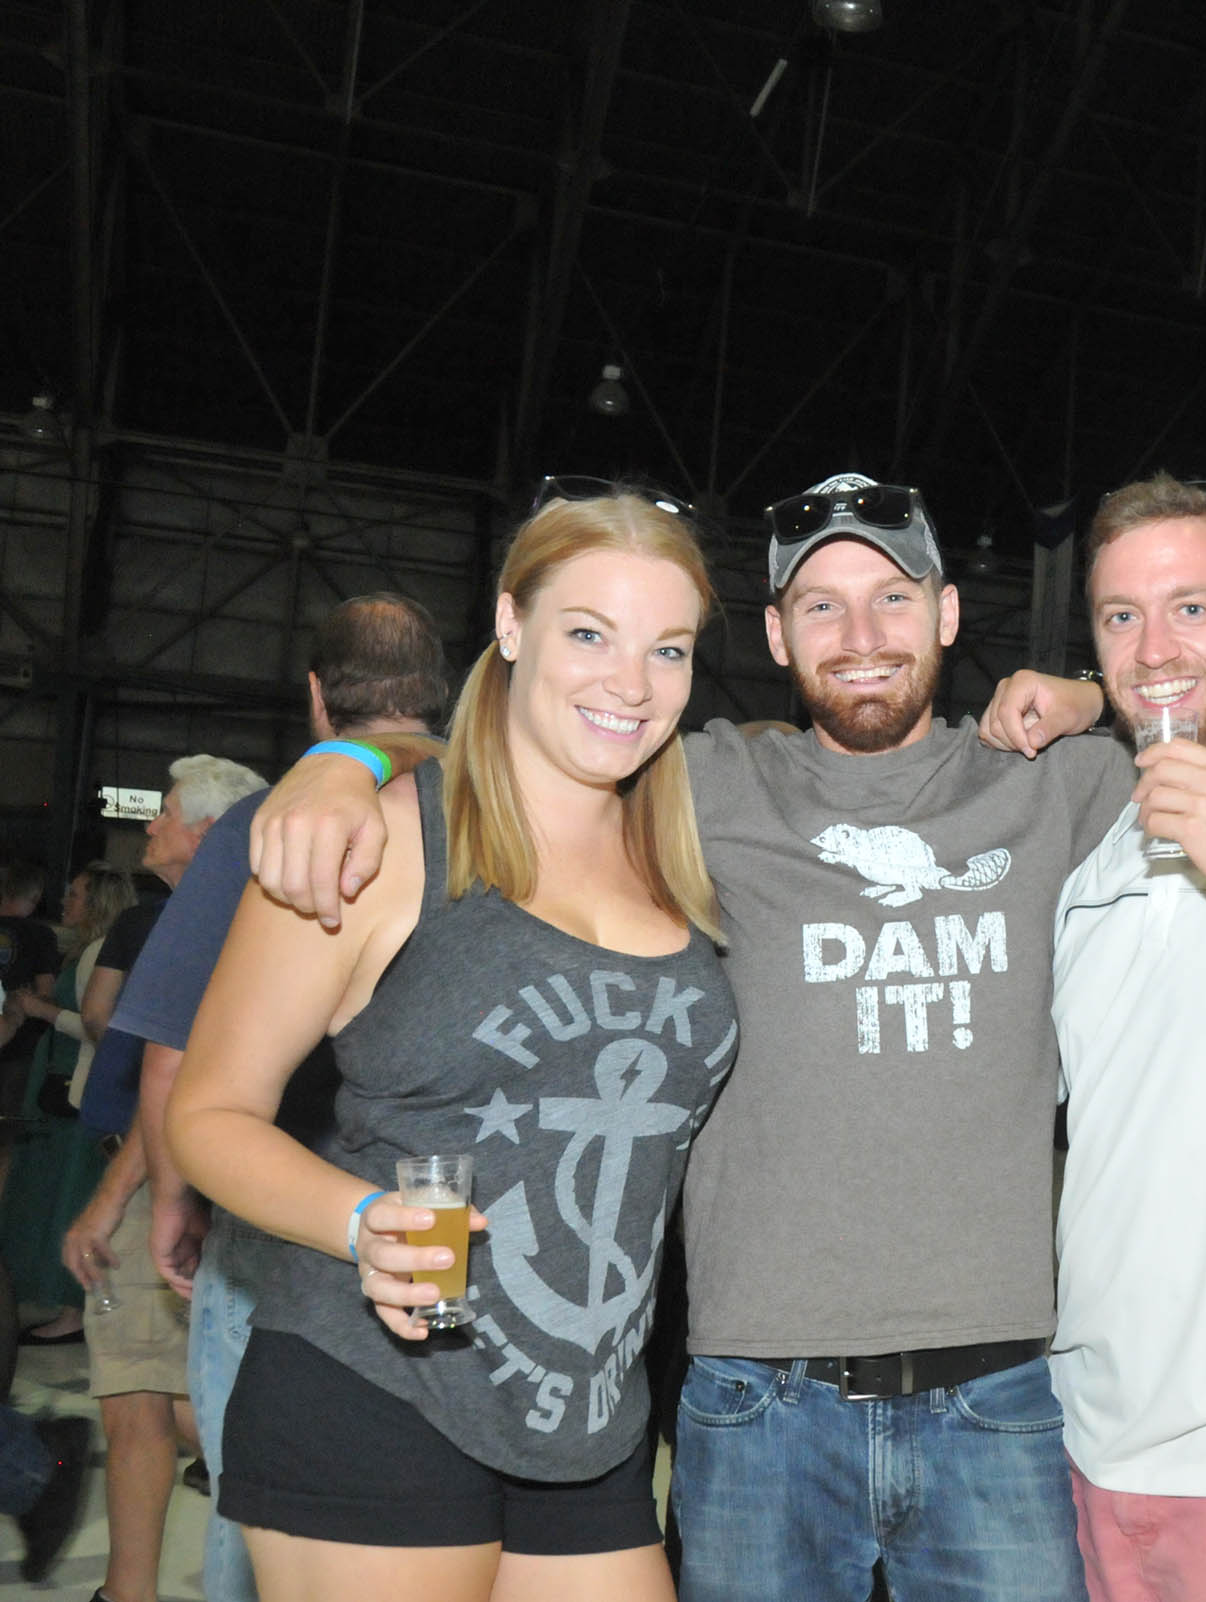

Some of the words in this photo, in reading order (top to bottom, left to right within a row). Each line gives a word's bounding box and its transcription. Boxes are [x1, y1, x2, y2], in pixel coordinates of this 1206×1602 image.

[129, 795, 145, 804] No
[802, 911, 1008, 983] DAM
[472, 970, 705, 1069] FUCK
[856, 980, 974, 1054] IT!
